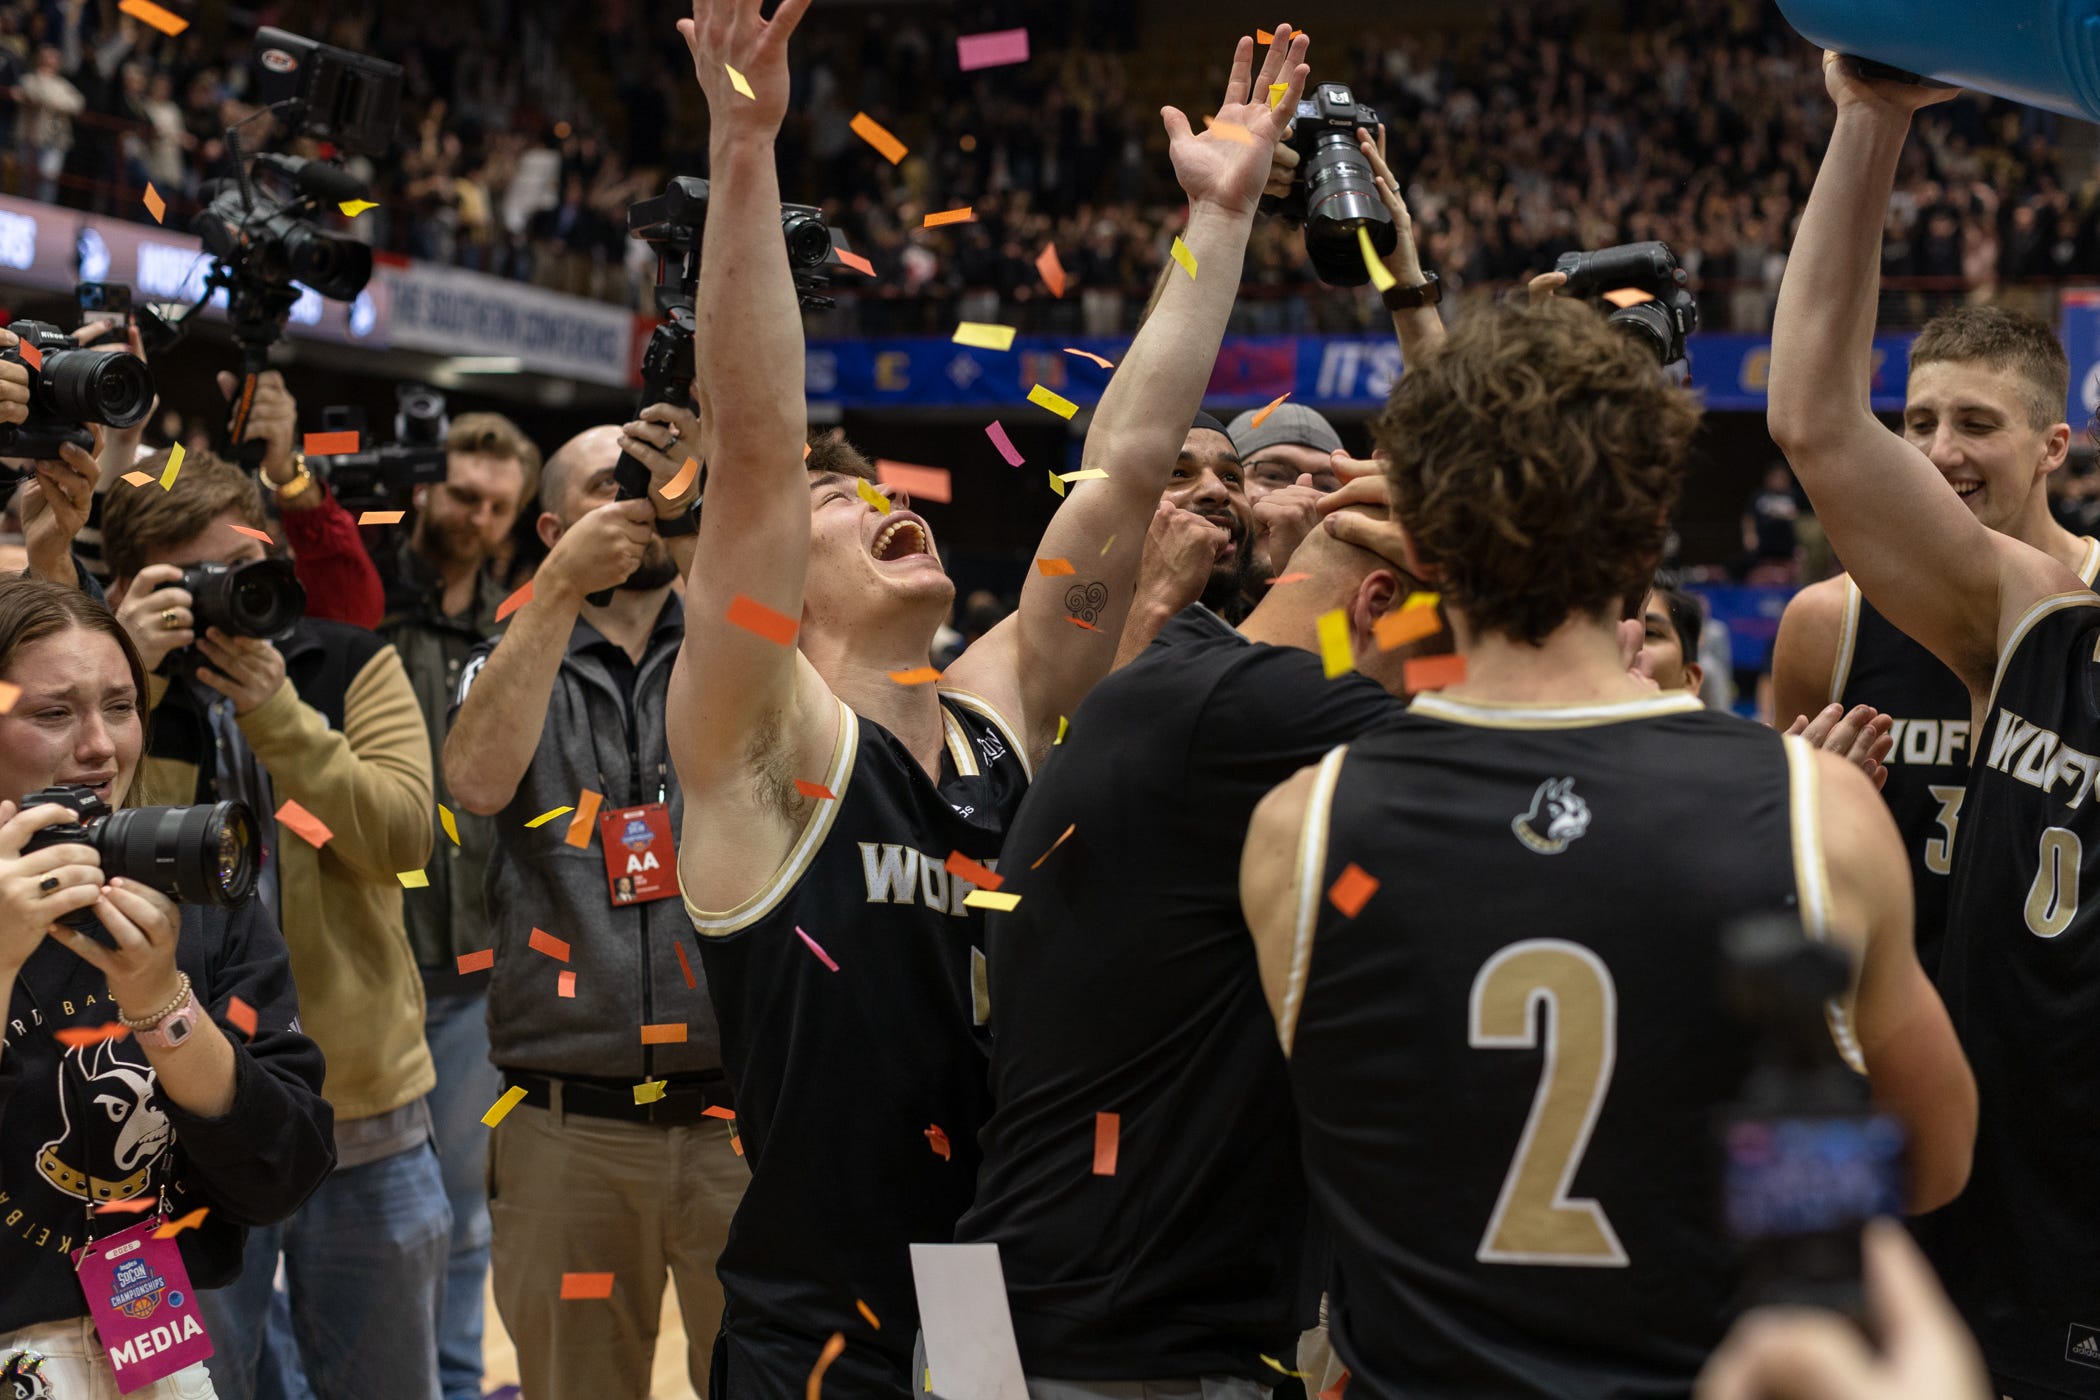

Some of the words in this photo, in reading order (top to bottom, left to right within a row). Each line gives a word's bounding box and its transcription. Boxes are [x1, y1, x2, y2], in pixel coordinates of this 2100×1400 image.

[1328, 118, 1353, 127] Canon
[40, 330, 64, 340] Nikon
[626, 850, 661, 874] AA
[2023, 826, 2083, 939] 0
[1467, 937, 1631, 1268] 2
[112, 1243, 135, 1257] 2025
[110, 1276, 165, 1308] CHAMPIONSHIPS
[109, 1313, 204, 1372] MEDIA
